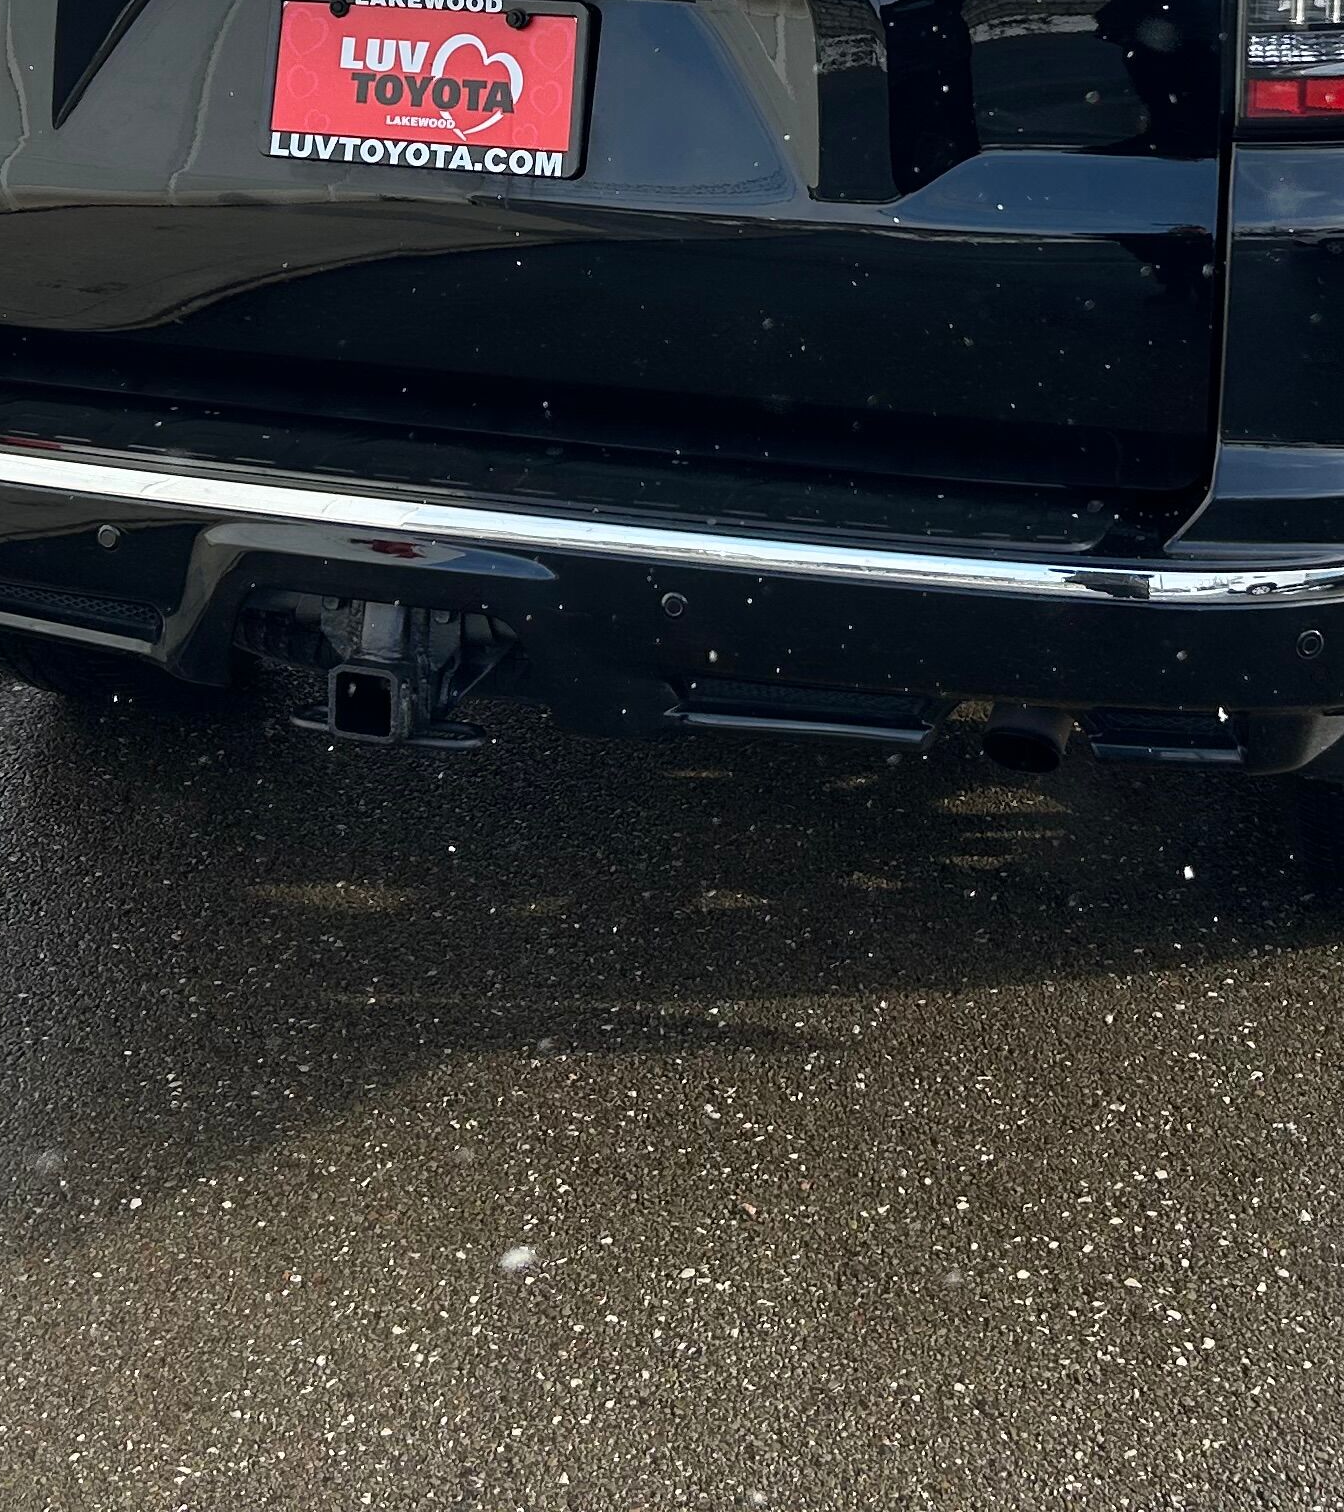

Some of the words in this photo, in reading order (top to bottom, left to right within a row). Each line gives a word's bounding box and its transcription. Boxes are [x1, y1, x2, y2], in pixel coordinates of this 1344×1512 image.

[339, 36, 431, 74] LUV
[351, 71, 515, 114] TOYOTA
[385, 114, 457, 130] LAKEWOOD
[269, 131, 564, 178] LUVTOYOTA.COM
